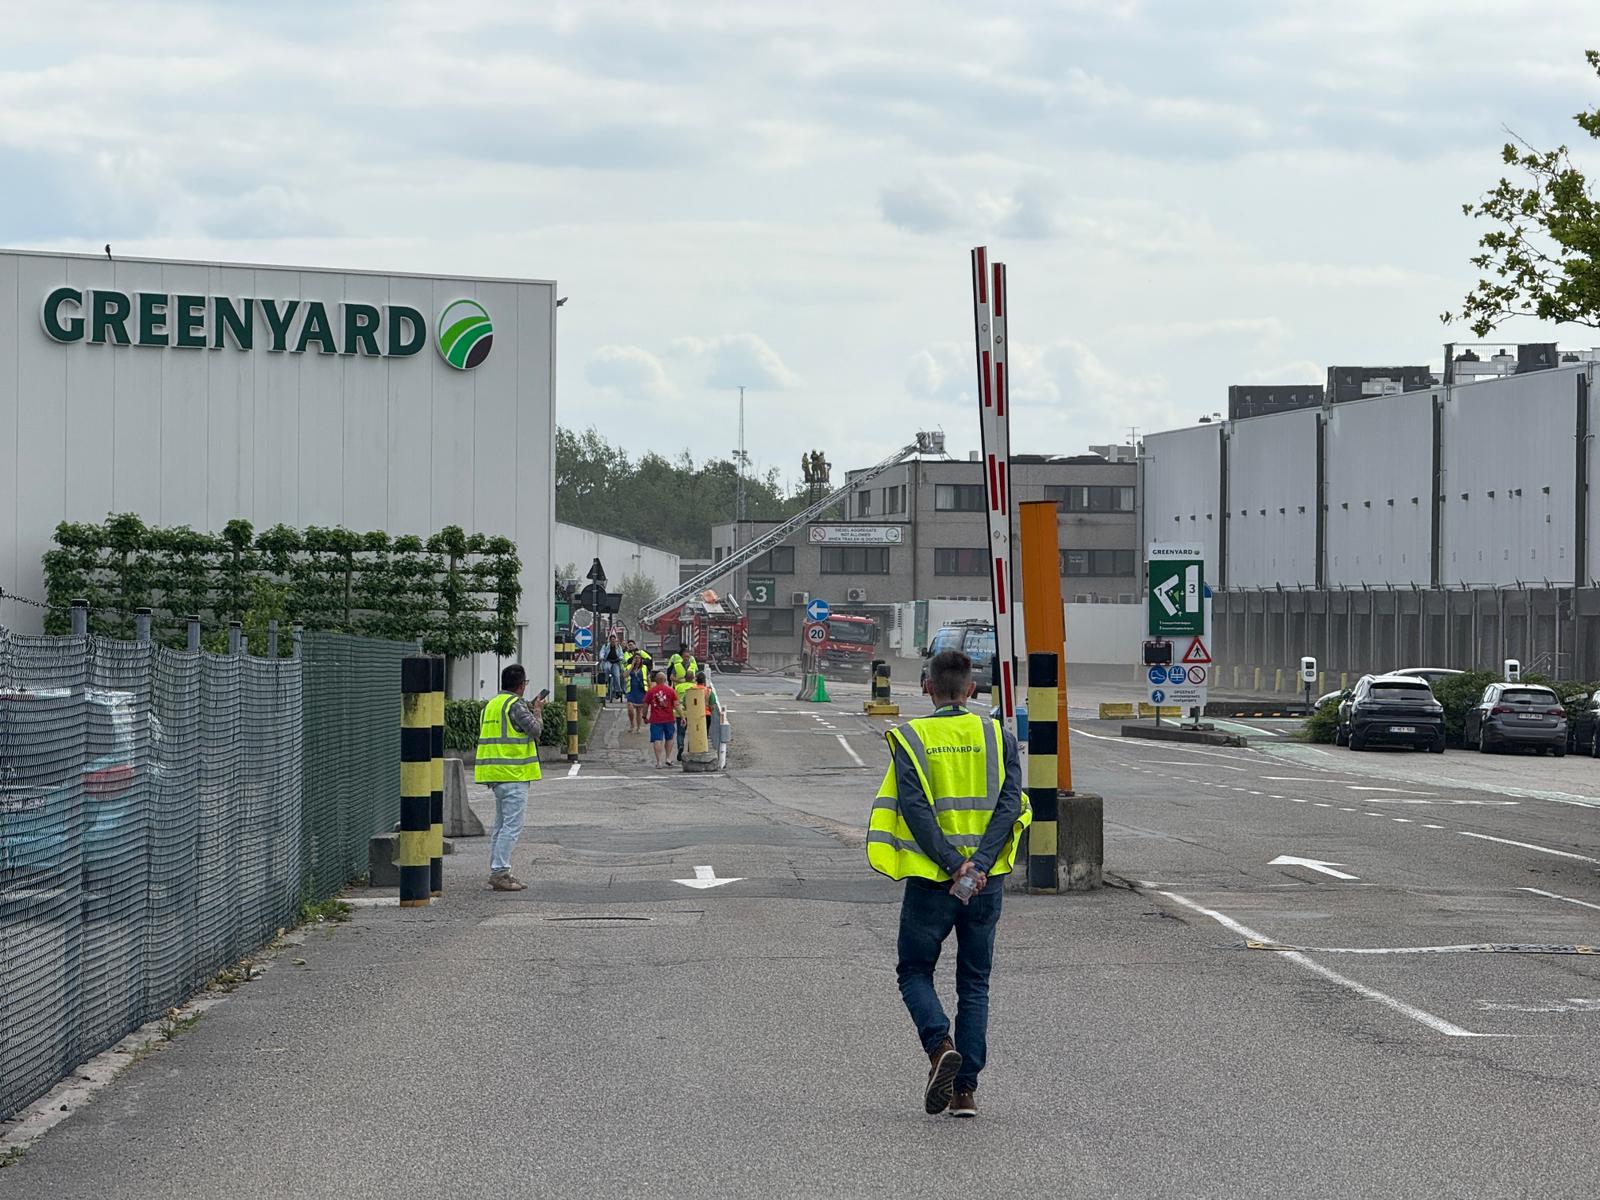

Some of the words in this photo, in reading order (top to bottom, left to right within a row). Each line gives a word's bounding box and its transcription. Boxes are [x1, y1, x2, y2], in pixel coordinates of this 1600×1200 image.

[41, 287, 427, 357] GREENYARD
[1157, 587, 1163, 597] 1
[1188, 583, 1196, 594] 3
[755, 586, 768, 603] 3
[811, 629, 824, 639] 20
[926, 746, 972, 755] GREENYARD
